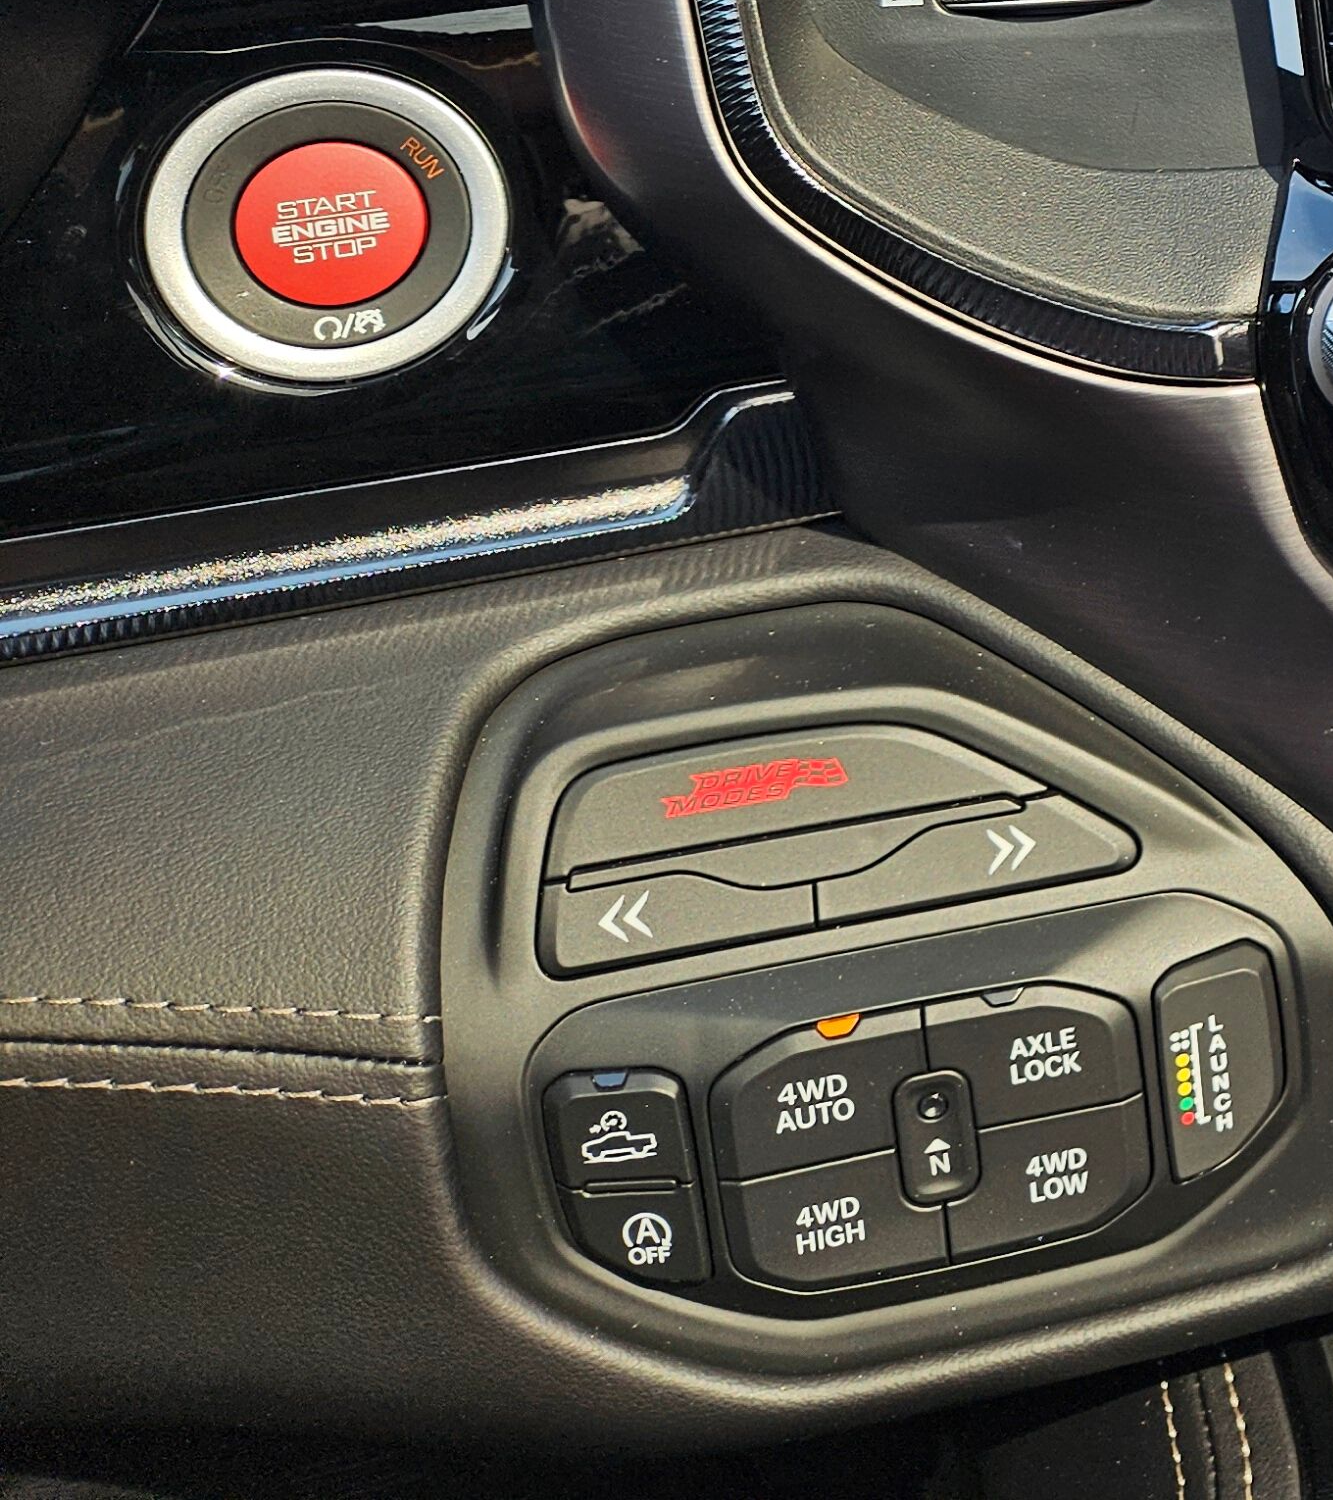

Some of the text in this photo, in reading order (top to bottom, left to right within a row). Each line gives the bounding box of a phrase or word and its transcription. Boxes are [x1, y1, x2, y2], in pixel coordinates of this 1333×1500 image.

[401, 136, 445, 180] RUN
[276, 189, 378, 220] START
[271, 211, 391, 244] ENGINE
[292, 236, 377, 264] STOP
[698, 761, 793, 791] DRIVE
[669, 782, 785, 816] MODES
[1009, 1026, 1077, 1061] AXLE
[1009, 1050, 1082, 1085] LOCK
[1206, 1014, 1234, 1132] LAUNCH
[777, 1074, 848, 1106] 4WD
[775, 1098, 855, 1134] AUTO
[929, 1151, 951, 1176] N
[1025, 1147, 1088, 1178] 4WD
[1029, 1170, 1089, 1203] LOW
[795, 1196, 860, 1229] 4WD
[795, 1219, 866, 1255] HIGH
[628, 1245, 672, 1265] OFF
